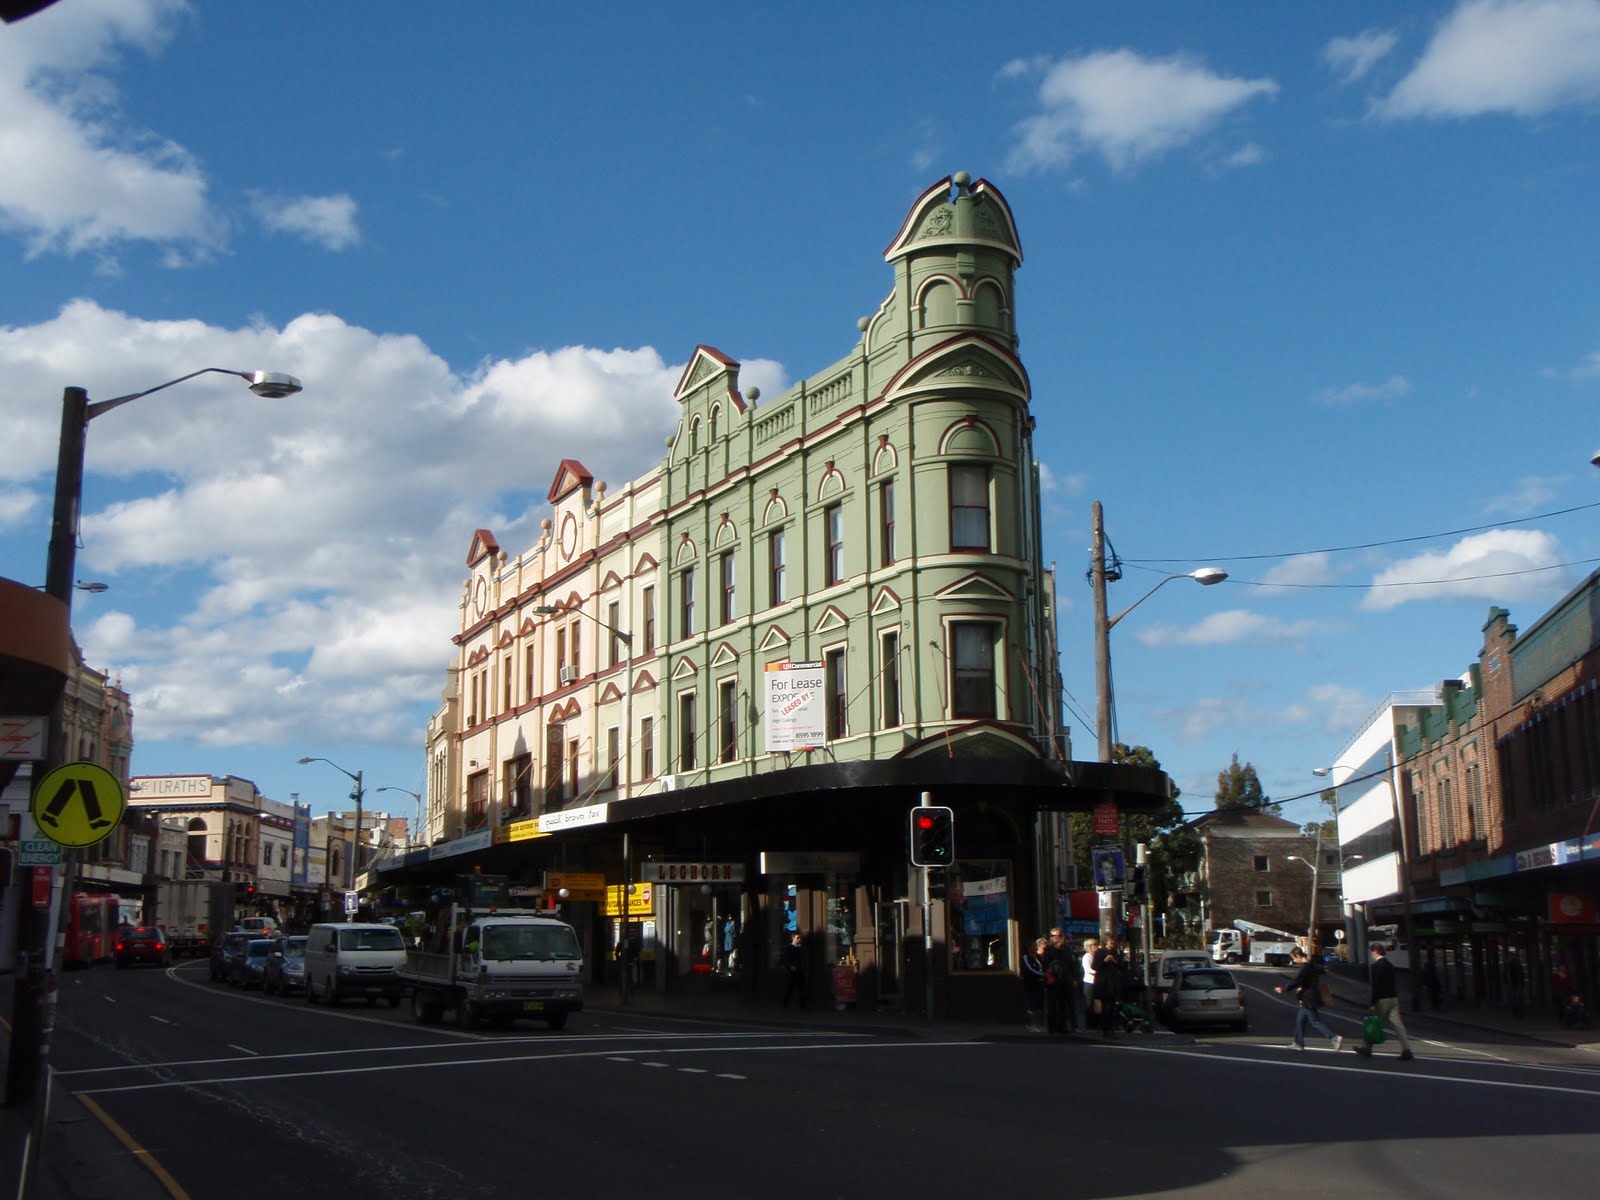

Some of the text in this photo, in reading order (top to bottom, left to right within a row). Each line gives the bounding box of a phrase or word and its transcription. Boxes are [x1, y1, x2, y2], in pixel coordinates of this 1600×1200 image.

[771, 678, 823, 691] For Lease
[781, 699, 802, 716] LEASED
[801, 692, 810, 702] BY
[565, 813, 585, 823] brown
[588, 809, 600, 818] fox
[24, 841, 56, 852] CLEAN
[21, 853, 60, 864] ENERGY
[658, 864, 732, 880] LEGHORN
